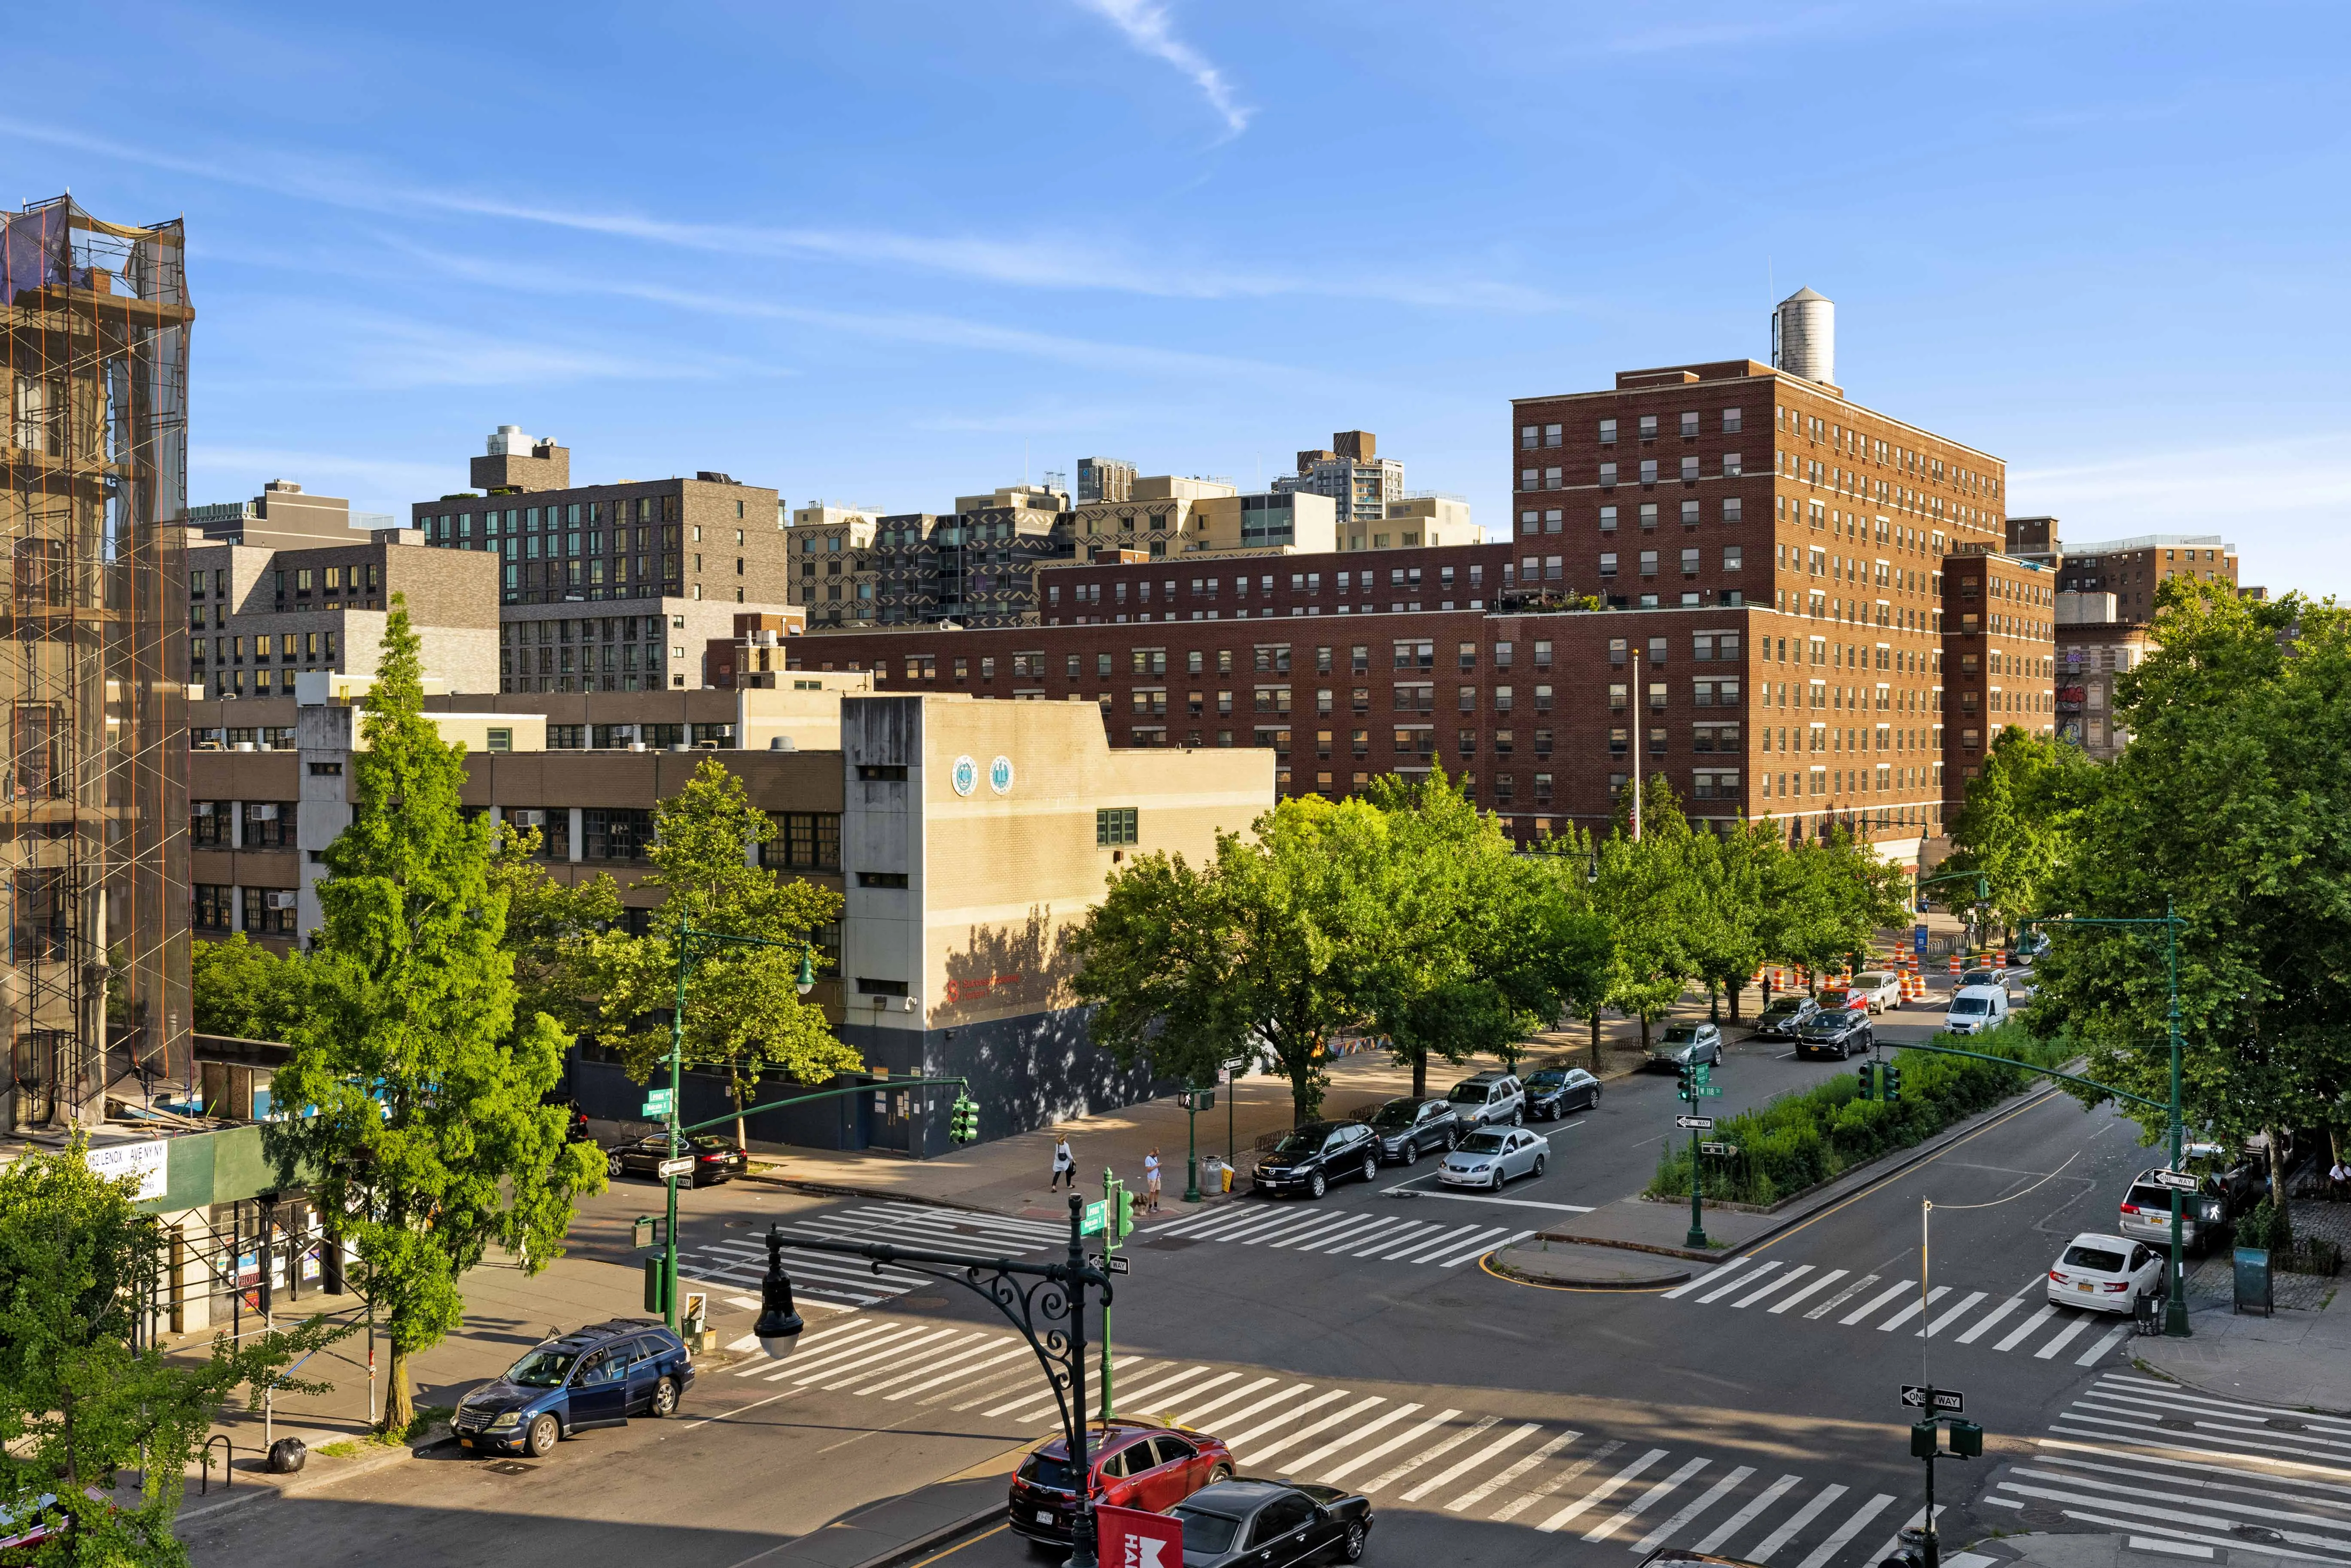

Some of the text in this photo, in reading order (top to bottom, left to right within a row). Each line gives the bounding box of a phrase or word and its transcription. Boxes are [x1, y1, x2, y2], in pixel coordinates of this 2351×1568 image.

[963, 978, 990, 988] Success
[650, 1092, 664, 1101] Lenox
[101, 1150, 123, 1165] LENOX
[130, 1147, 142, 1161] AVE
[144, 1145, 153, 1158] NY
[154, 1144, 163, 1157] NY
[1087, 1206, 1100, 1216] Lenox
[238, 1267, 259, 1276] ASSPORT
[238, 1273, 259, 1285] PHOTO
[1910, 1392, 1958, 1406] ONE WAY
[1125, 1533, 1138, 1568] HA
